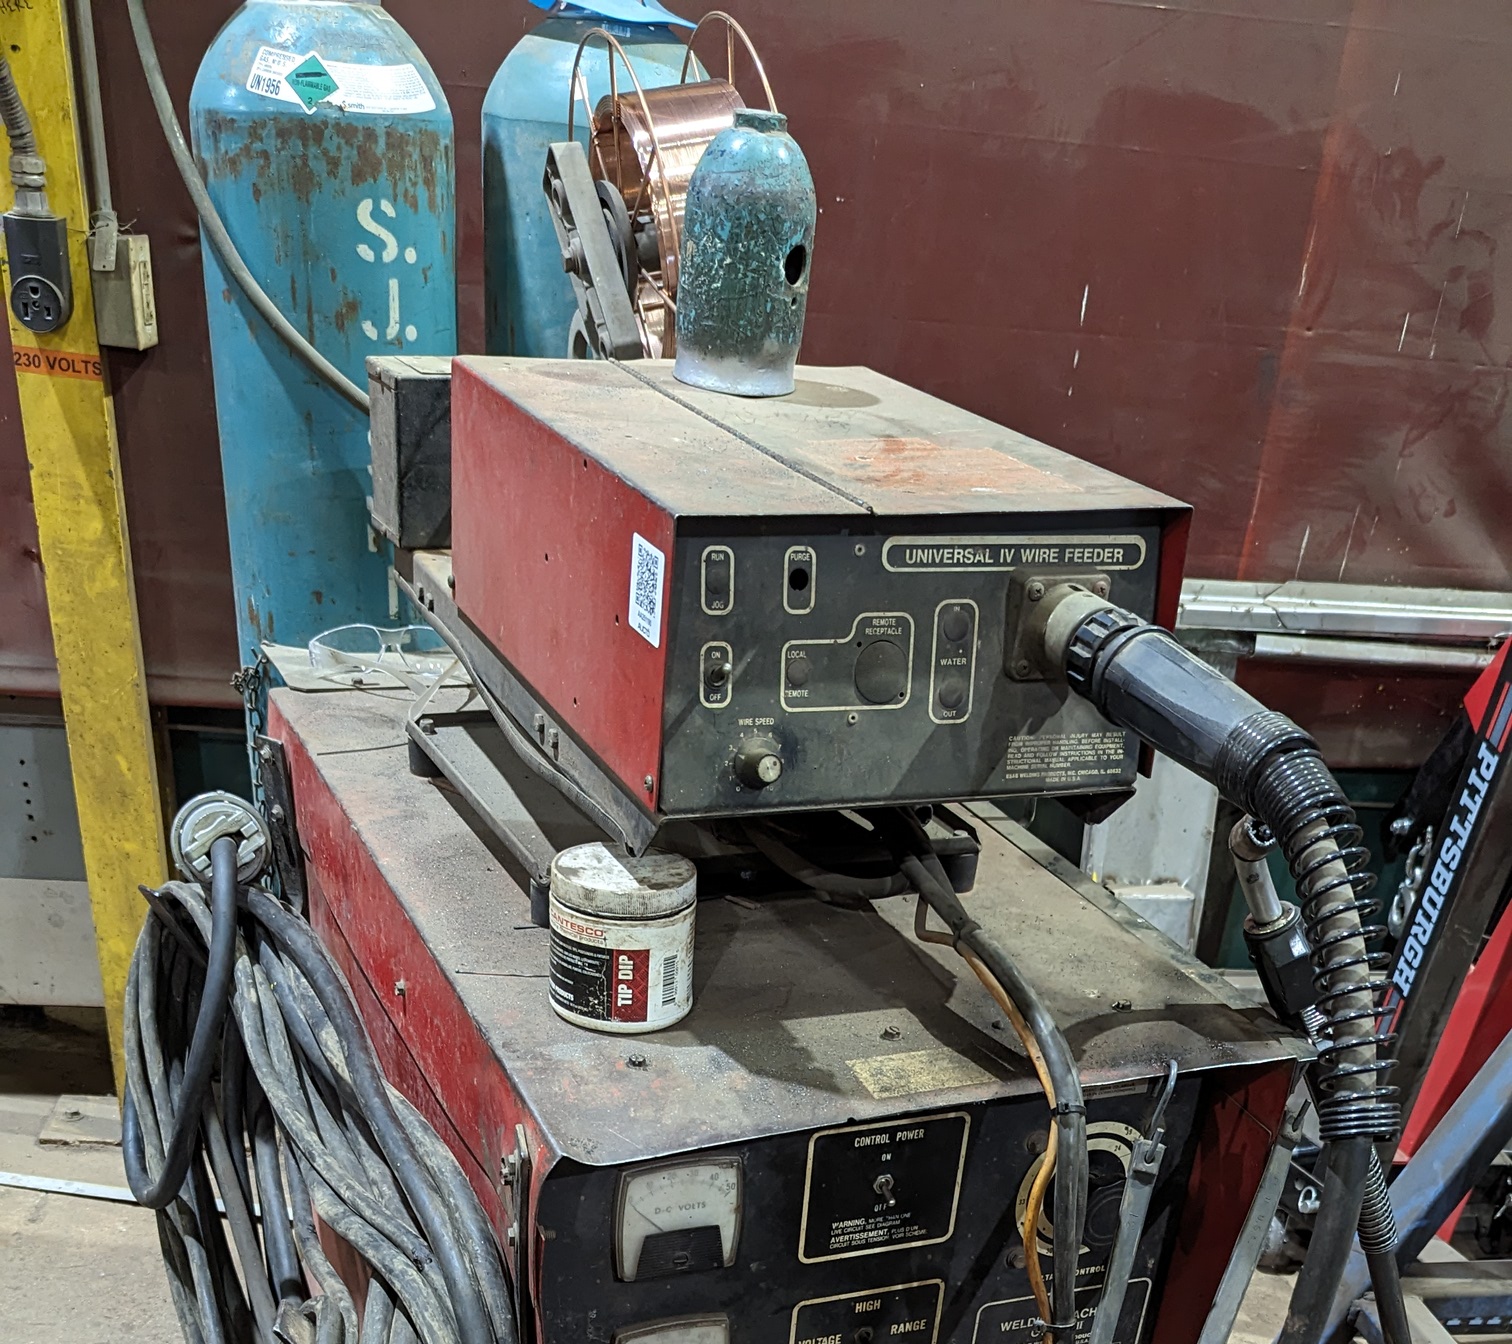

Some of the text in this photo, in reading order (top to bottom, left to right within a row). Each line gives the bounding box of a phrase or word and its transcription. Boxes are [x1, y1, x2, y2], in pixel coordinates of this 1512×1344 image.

[250, 73, 281, 96] UN1956
[307, 97, 313, 105] 2
[14, 352, 102, 376] 230 VOLTS
[711, 553, 725, 561] RUN
[790, 553, 811, 562] PURGE
[905, 548, 1124, 564] UNIVERSAL IV WIRE FEEDER
[711, 601, 724, 609] JOG
[872, 618, 897, 626] REMOTE
[865, 627, 902, 635] RECEPTACLE
[711, 651, 721, 659] ON
[787, 650, 807, 658] LOCAL
[939, 657, 967, 666] WATER
[709, 693, 722, 701] OFF
[942, 710, 956, 718] OUT
[738, 717, 775, 726] WIRE SPEED
[1392, 740, 1500, 998] PITTSBURGH
[617, 954, 634, 1007] TIP DIP
[854, 1128, 925, 1148] CONTROL POWER
[881, 1153, 892, 1161] ON
[709, 1172, 719, 1181] 40
[725, 1182, 736, 1191] 50
[678, 1201, 706, 1211] VOLTS
[874, 1203, 887, 1212] OFF
[843, 1225, 864, 1233] CIRCUIT
[829, 1242, 850, 1250] CIRCUIT
[1075, 1265, 1105, 1276] ONTROL
[855, 1299, 881, 1314] HIGH
[890, 1319, 927, 1336] RANGE
[1000, 1316, 1042, 1332] WELD
